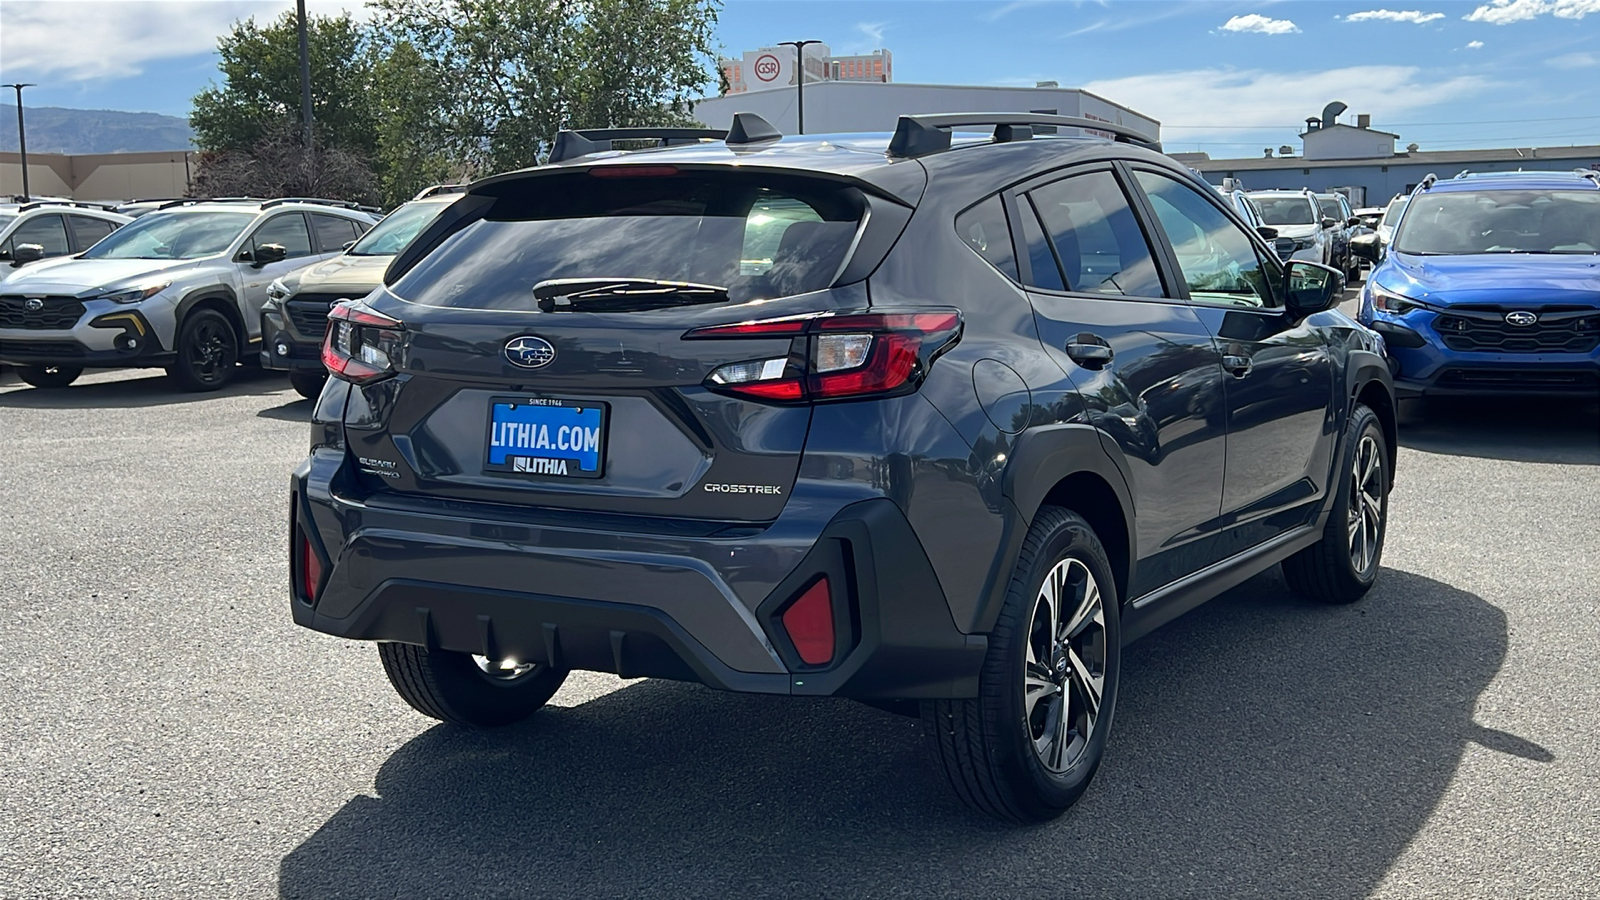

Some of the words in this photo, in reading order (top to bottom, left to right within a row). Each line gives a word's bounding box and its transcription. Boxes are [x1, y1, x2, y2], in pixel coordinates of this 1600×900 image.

[758, 62, 777, 74] GSR
[529, 398, 548, 406] SINCE
[548, 399, 563, 407] 1946
[491, 421, 600, 453] LITHIA.COM
[359, 457, 397, 468] SUBARU
[525, 457, 568, 475] LITHIA
[704, 483, 782, 494] CROSSTREK
